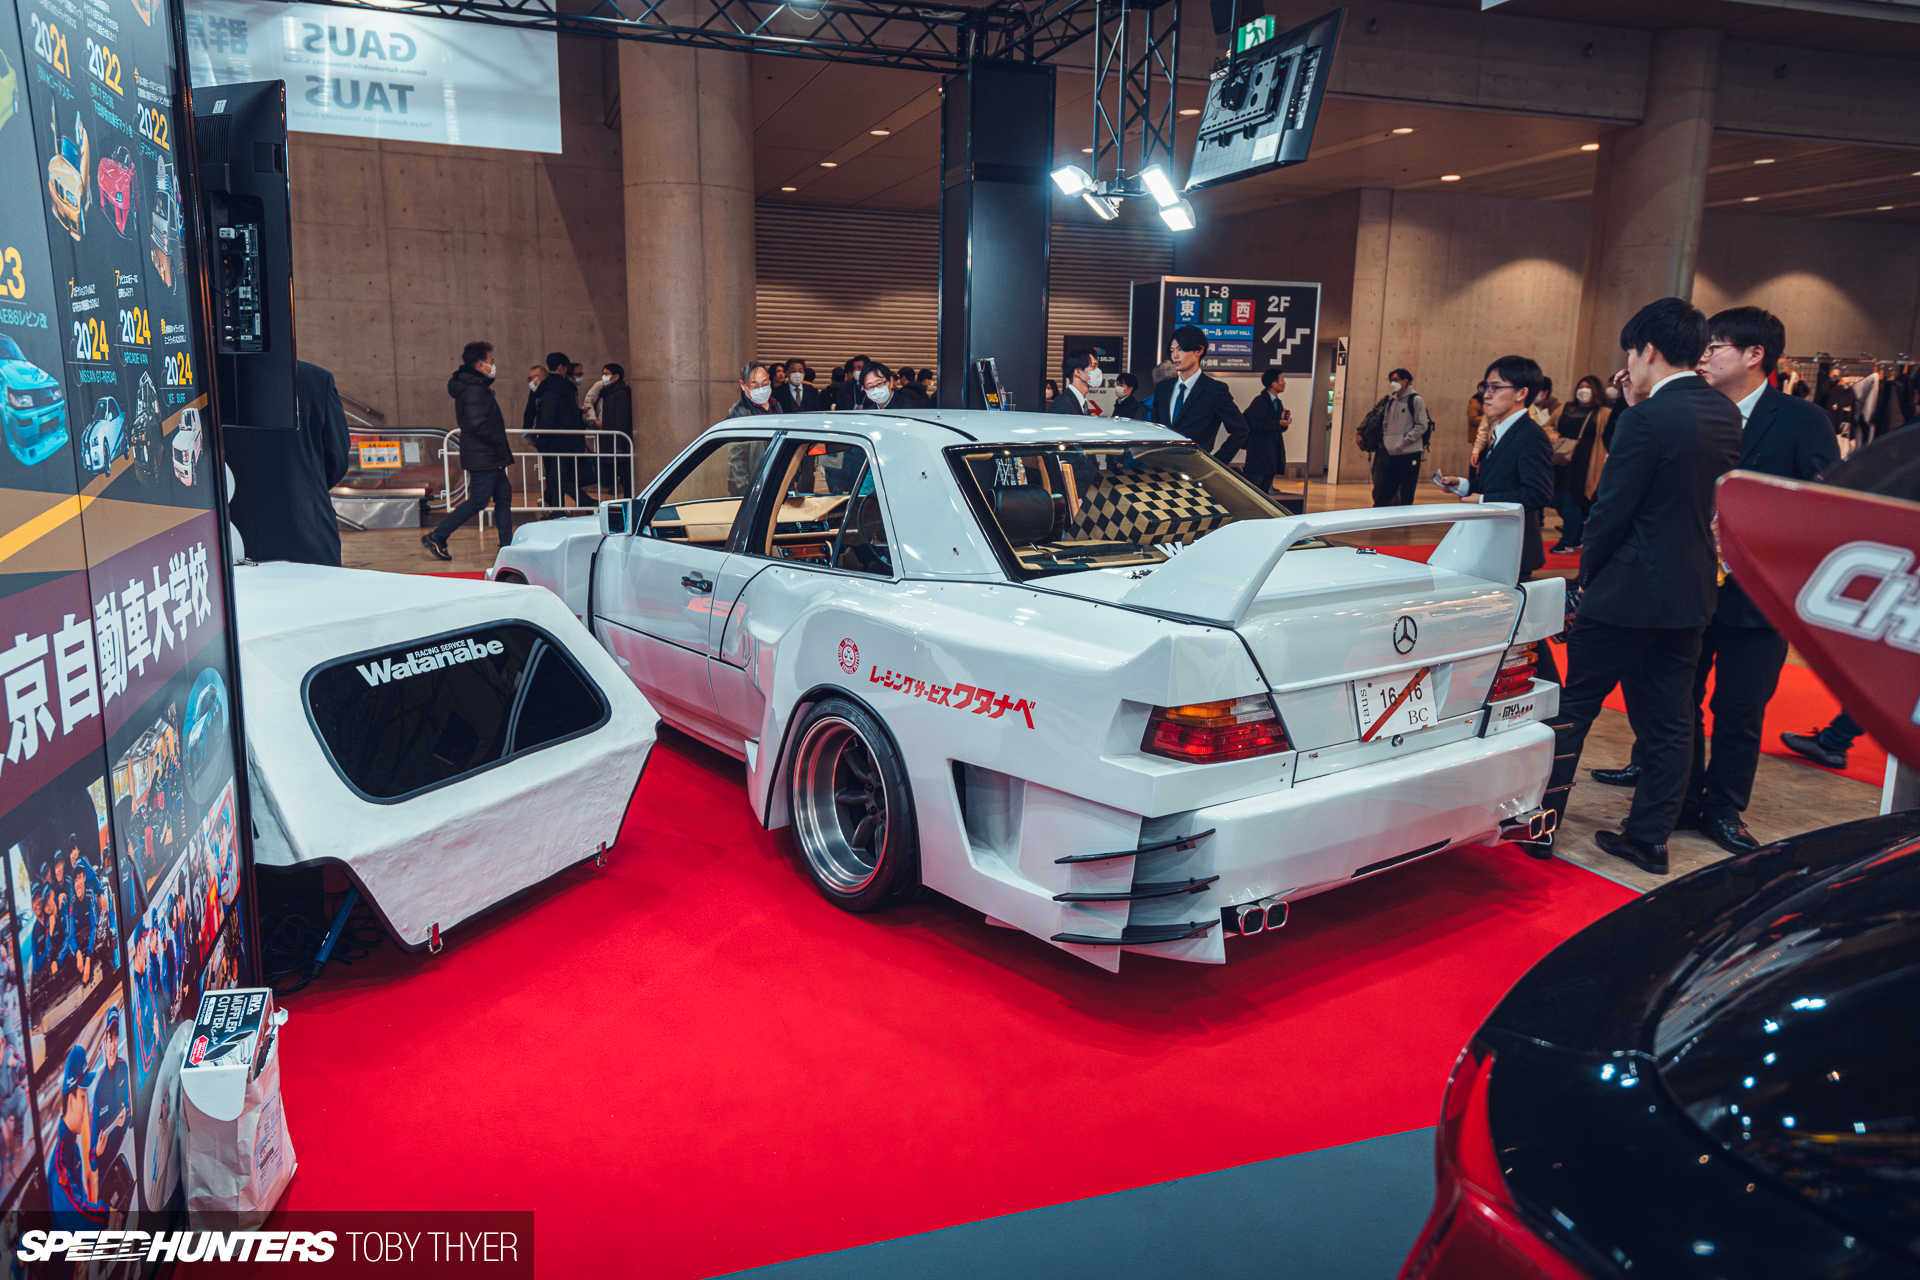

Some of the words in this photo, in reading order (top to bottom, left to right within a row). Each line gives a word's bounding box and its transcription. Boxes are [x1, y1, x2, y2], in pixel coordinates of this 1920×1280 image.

[31, 12, 70, 78] 2021
[86, 37, 124, 96] 2022
[137, 102, 170, 150] 2022
[1176, 288, 1200, 297] HALL
[1180, 300, 1195, 316] 東
[1209, 301, 1223, 317] 中
[1268, 296, 1291, 312] 2F
[120, 306, 151, 345] 2024
[1236, 302, 1250, 318] 西
[73, 318, 110, 361] 2024
[164, 352, 193, 385] 2024
[0, 542, 212, 777] 京自動車大学校
[356, 638, 504, 687] Watanabe
[414, 646, 439, 658] RACING
[440, 640, 467, 652] SERVICE
[1360, 689, 1371, 725] taus
[1408, 707, 1429, 725] BC
[211, 996, 231, 1029] CUTTER
[224, 994, 244, 1032] MUFFLER
